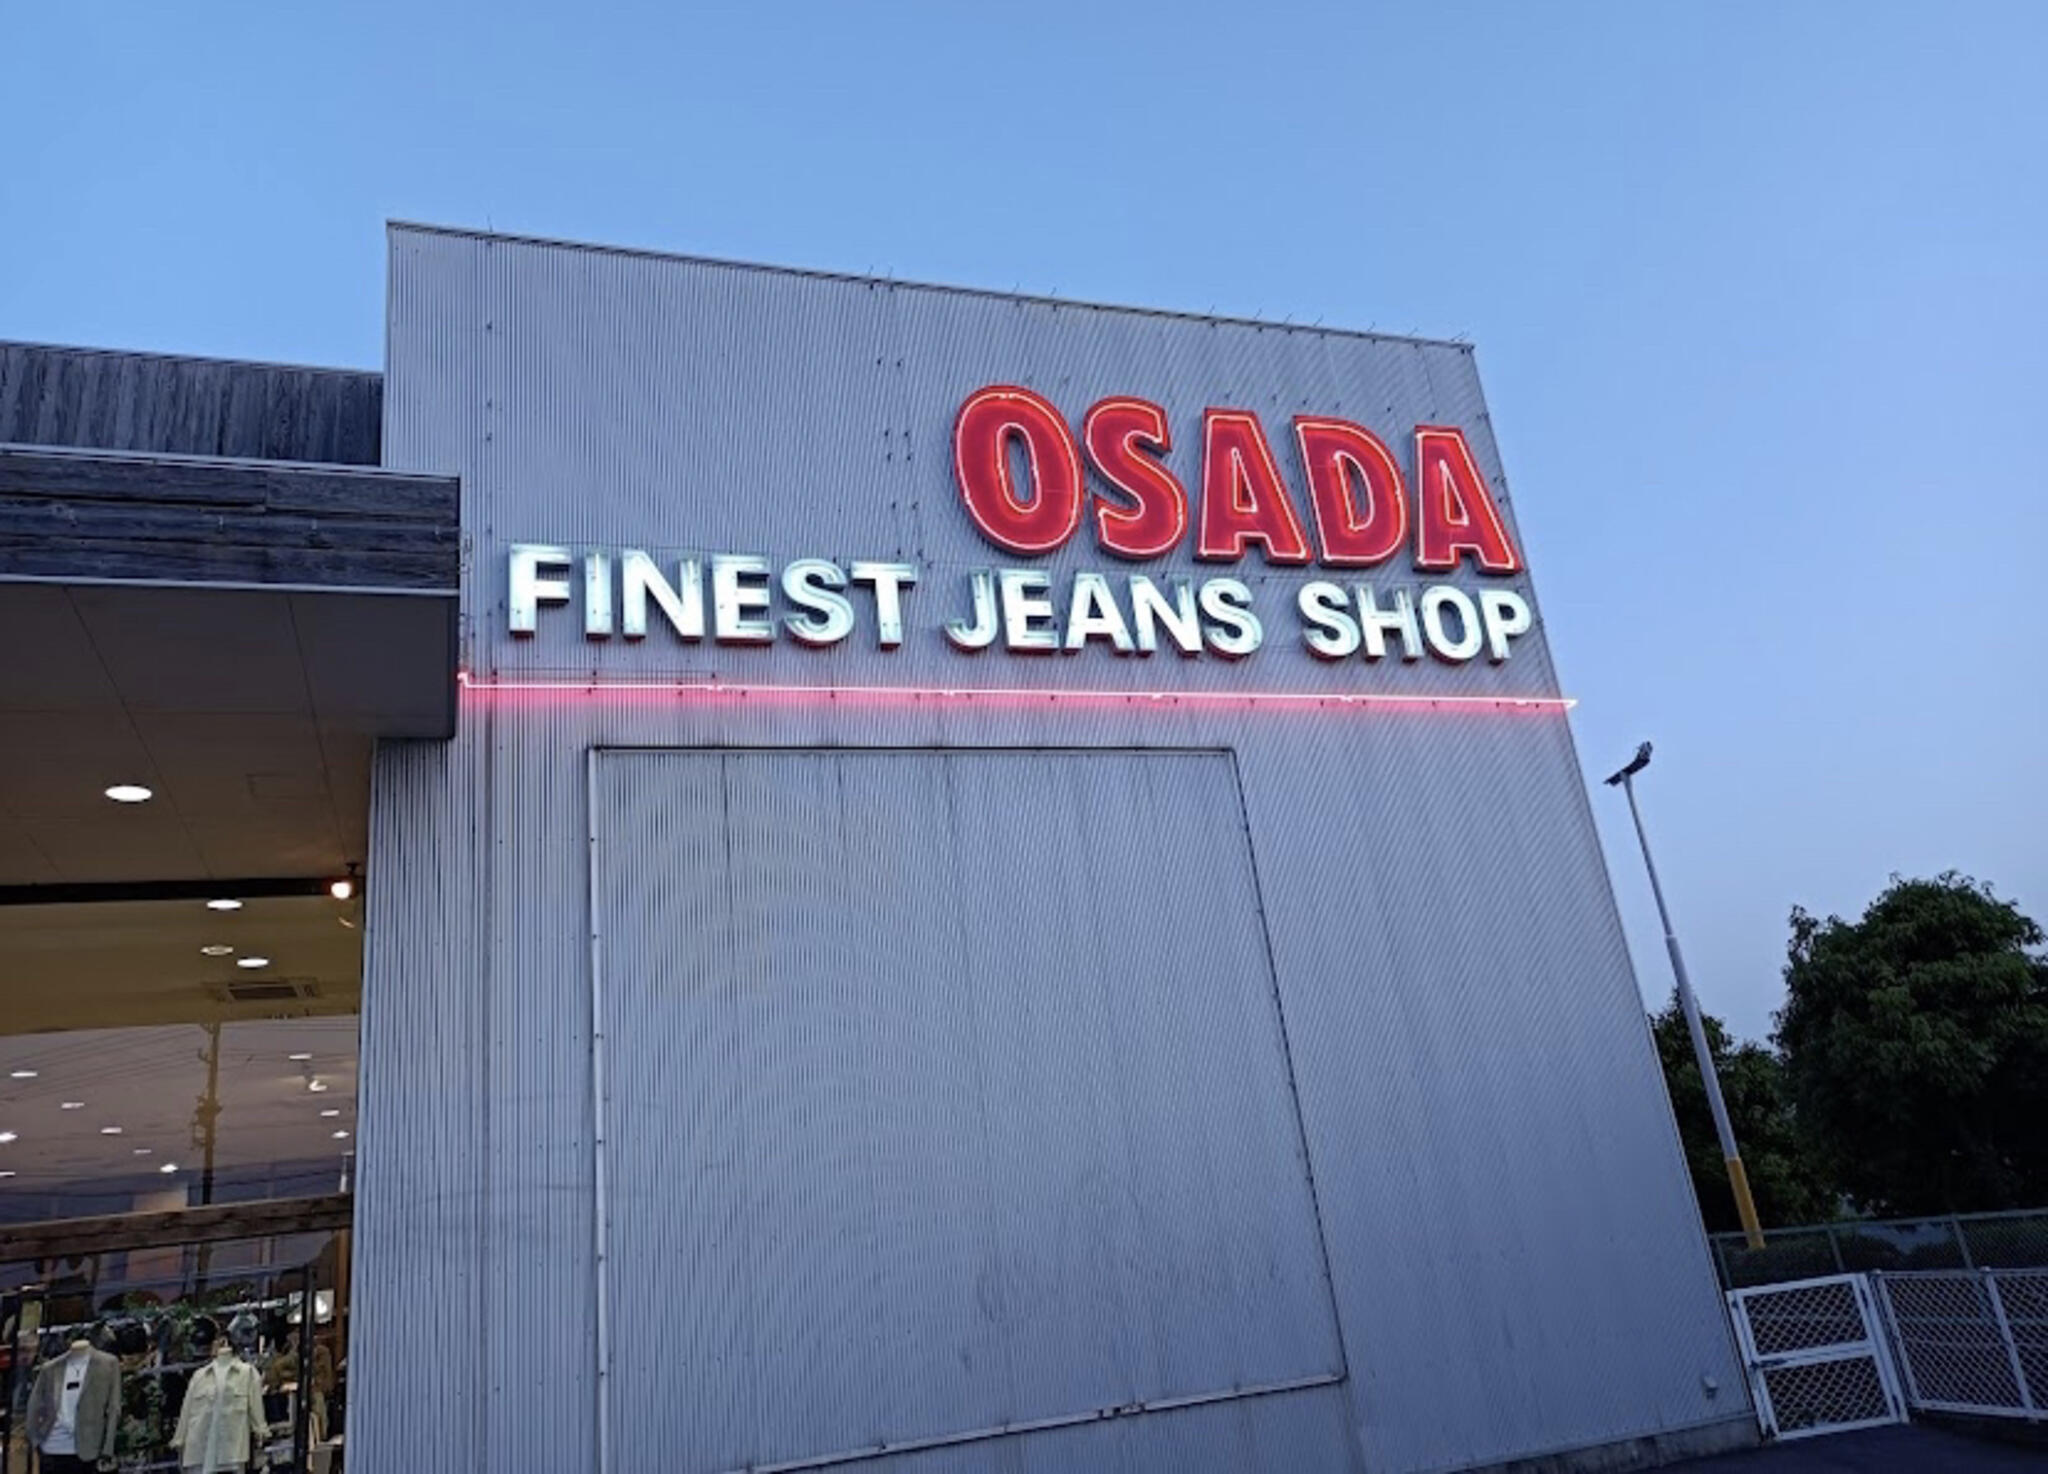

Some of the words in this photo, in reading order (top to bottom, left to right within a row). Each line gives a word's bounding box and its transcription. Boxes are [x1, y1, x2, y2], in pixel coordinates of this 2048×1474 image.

[953, 384, 1522, 574] OSADA
[507, 543, 918, 648] FINEST
[945, 567, 1263, 658] JEANS
[1298, 582, 1532, 662] SHOP
